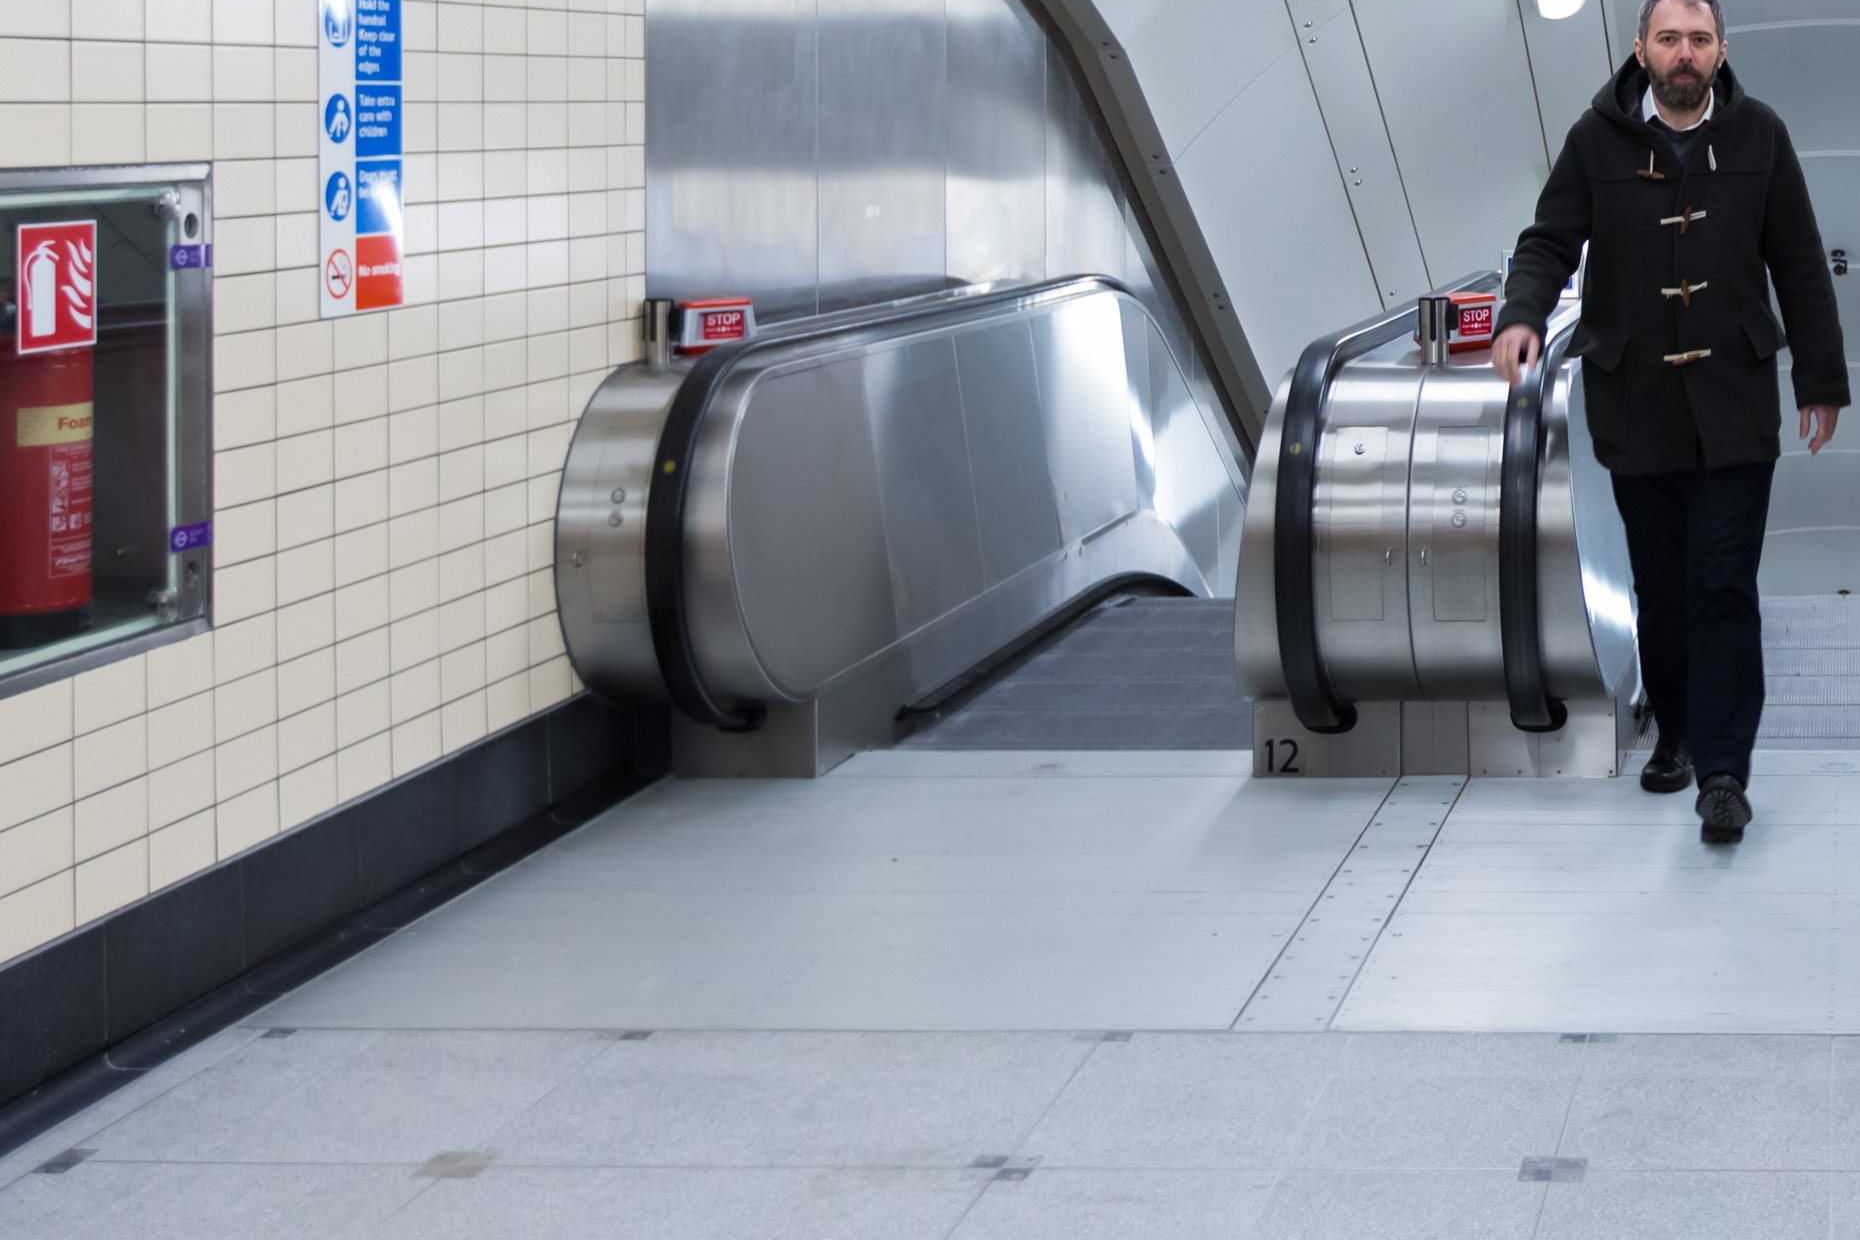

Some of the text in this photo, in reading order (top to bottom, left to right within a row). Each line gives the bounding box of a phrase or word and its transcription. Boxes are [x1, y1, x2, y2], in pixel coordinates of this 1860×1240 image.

[378, 0, 391, 11] the
[358, 12, 387, 26] handrail
[358, 28, 396, 44] Keep clear
[358, 44, 382, 57] of the
[358, 60, 380, 75] edges
[359, 94, 396, 107] Take extra
[359, 109, 393, 122] care with
[359, 125, 388, 138] children
[358, 262, 401, 277] No smoking
[707, 313, 741, 327] STOP
[1463, 309, 1490, 323] STOP
[1264, 738, 1300, 773] 12
